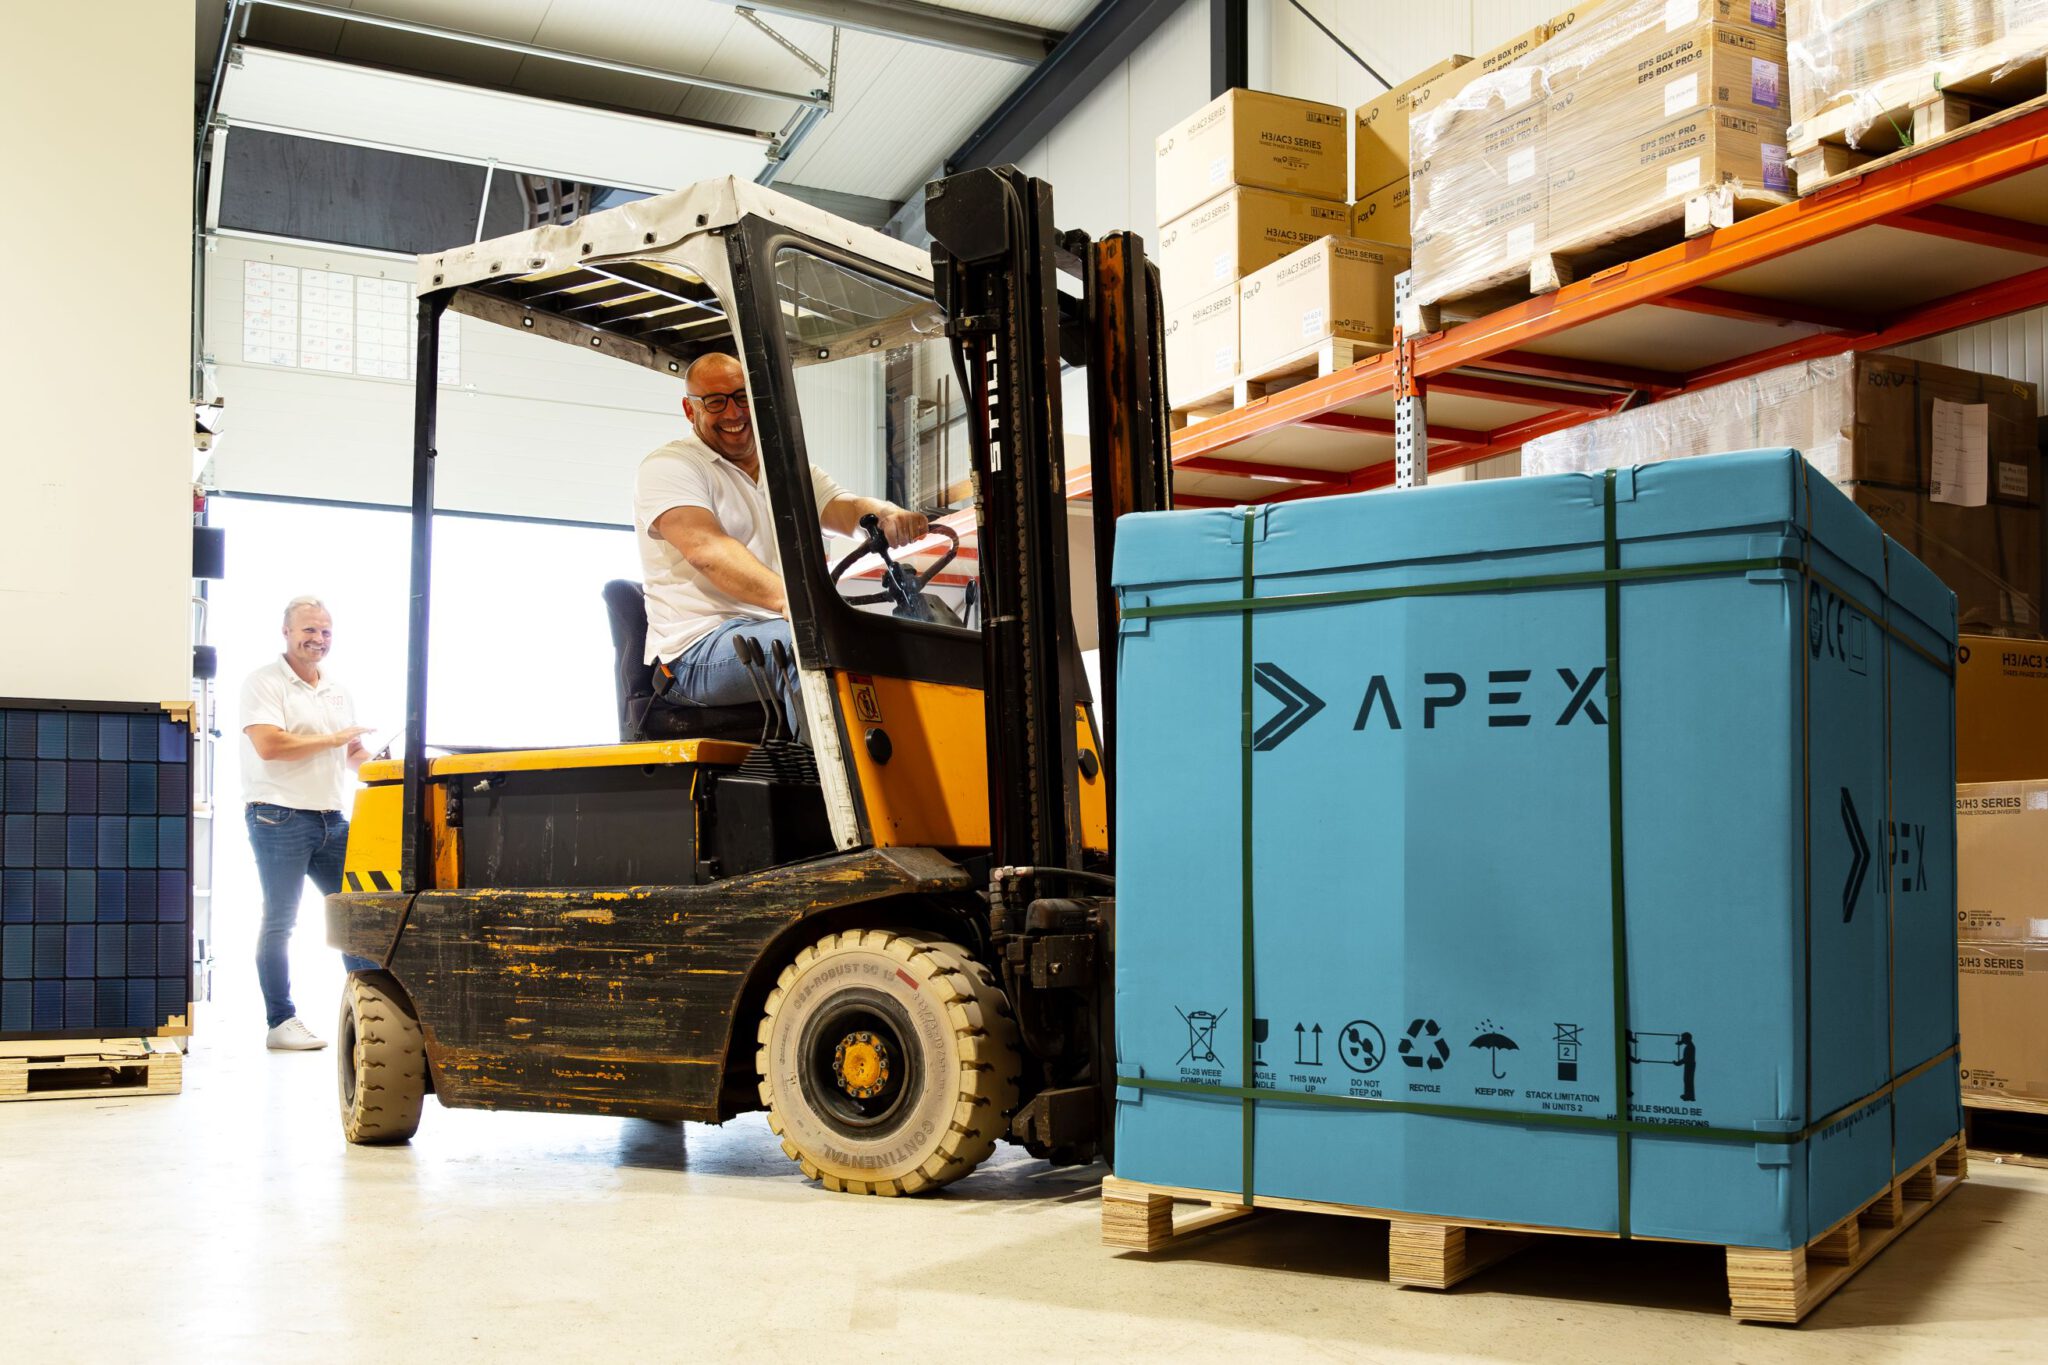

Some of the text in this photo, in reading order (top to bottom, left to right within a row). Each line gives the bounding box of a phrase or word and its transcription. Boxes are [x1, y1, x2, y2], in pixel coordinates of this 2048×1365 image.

[1553, 21, 1567, 34] FOX
[1483, 57, 1497, 69] EPS
[1497, 48, 1512, 61] BOX
[1513, 40, 1528, 53] PRO
[1638, 40, 1694, 71] EPS BOX PRO
[1638, 49, 1703, 84] EPS BOX PRO-G
[1411, 96, 1424, 109] FOX
[1552, 99, 1566, 111] FOX
[1359, 114, 1372, 128] FOX
[1679, 124, 1697, 136] PRO
[1261, 131, 1322, 150] H3/AC3 SERIES
[1211, 201, 1231, 217] SERIES
[1358, 212, 1370, 225] FOX
[1266, 227, 1297, 240] H3/AC3
[1335, 247, 1358, 257] AC3/H3
[1359, 250, 1384, 261] SERIES
[1276, 262, 1299, 281] H3/AC3
[1299, 252, 1321, 271] SERIES
[1243, 289, 1254, 301] FOX
[1192, 303, 1213, 321] H3/AC3
[1213, 295, 1232, 311] SERIES
[1868, 372, 1889, 387] FOX
[2003, 653, 2042, 669] H3/AC3
[1353, 666, 1609, 732] APEX
[1956, 797, 2021, 810] 3/H3 SERIES
[1959, 957, 2024, 969] 3/H3 SERIES
[1563, 1047, 1570, 1057] 2
[1200, 1069, 1222, 1078] WEEE
[1255, 1072, 1276, 1080] AGILE
[1290, 1074, 1327, 1085] THIS WAY
[1180, 1077, 1222, 1086] COMPLIANT
[1256, 1081, 1276, 1089] NDLE
[1351, 1078, 1380, 1088] DO NOT
[1305, 1084, 1316, 1093] UP
[1349, 1087, 1382, 1098] STEP ON
[1409, 1083, 1441, 1094] RECYCLE
[1475, 1086, 1515, 1098] KEEP DRY
[1525, 1090, 1600, 1103] STACK LIMITATION
[1542, 1102, 1583, 1112] IN UNITS 2
[1653, 1105, 1689, 1116] SHOULD
[1690, 1107, 1703, 1116] BE
[1648, 1116, 1660, 1124] BY
[1667, 1118, 1710, 1128] PERSONS
[823, 1119, 936, 1170] CONTINENTAL
